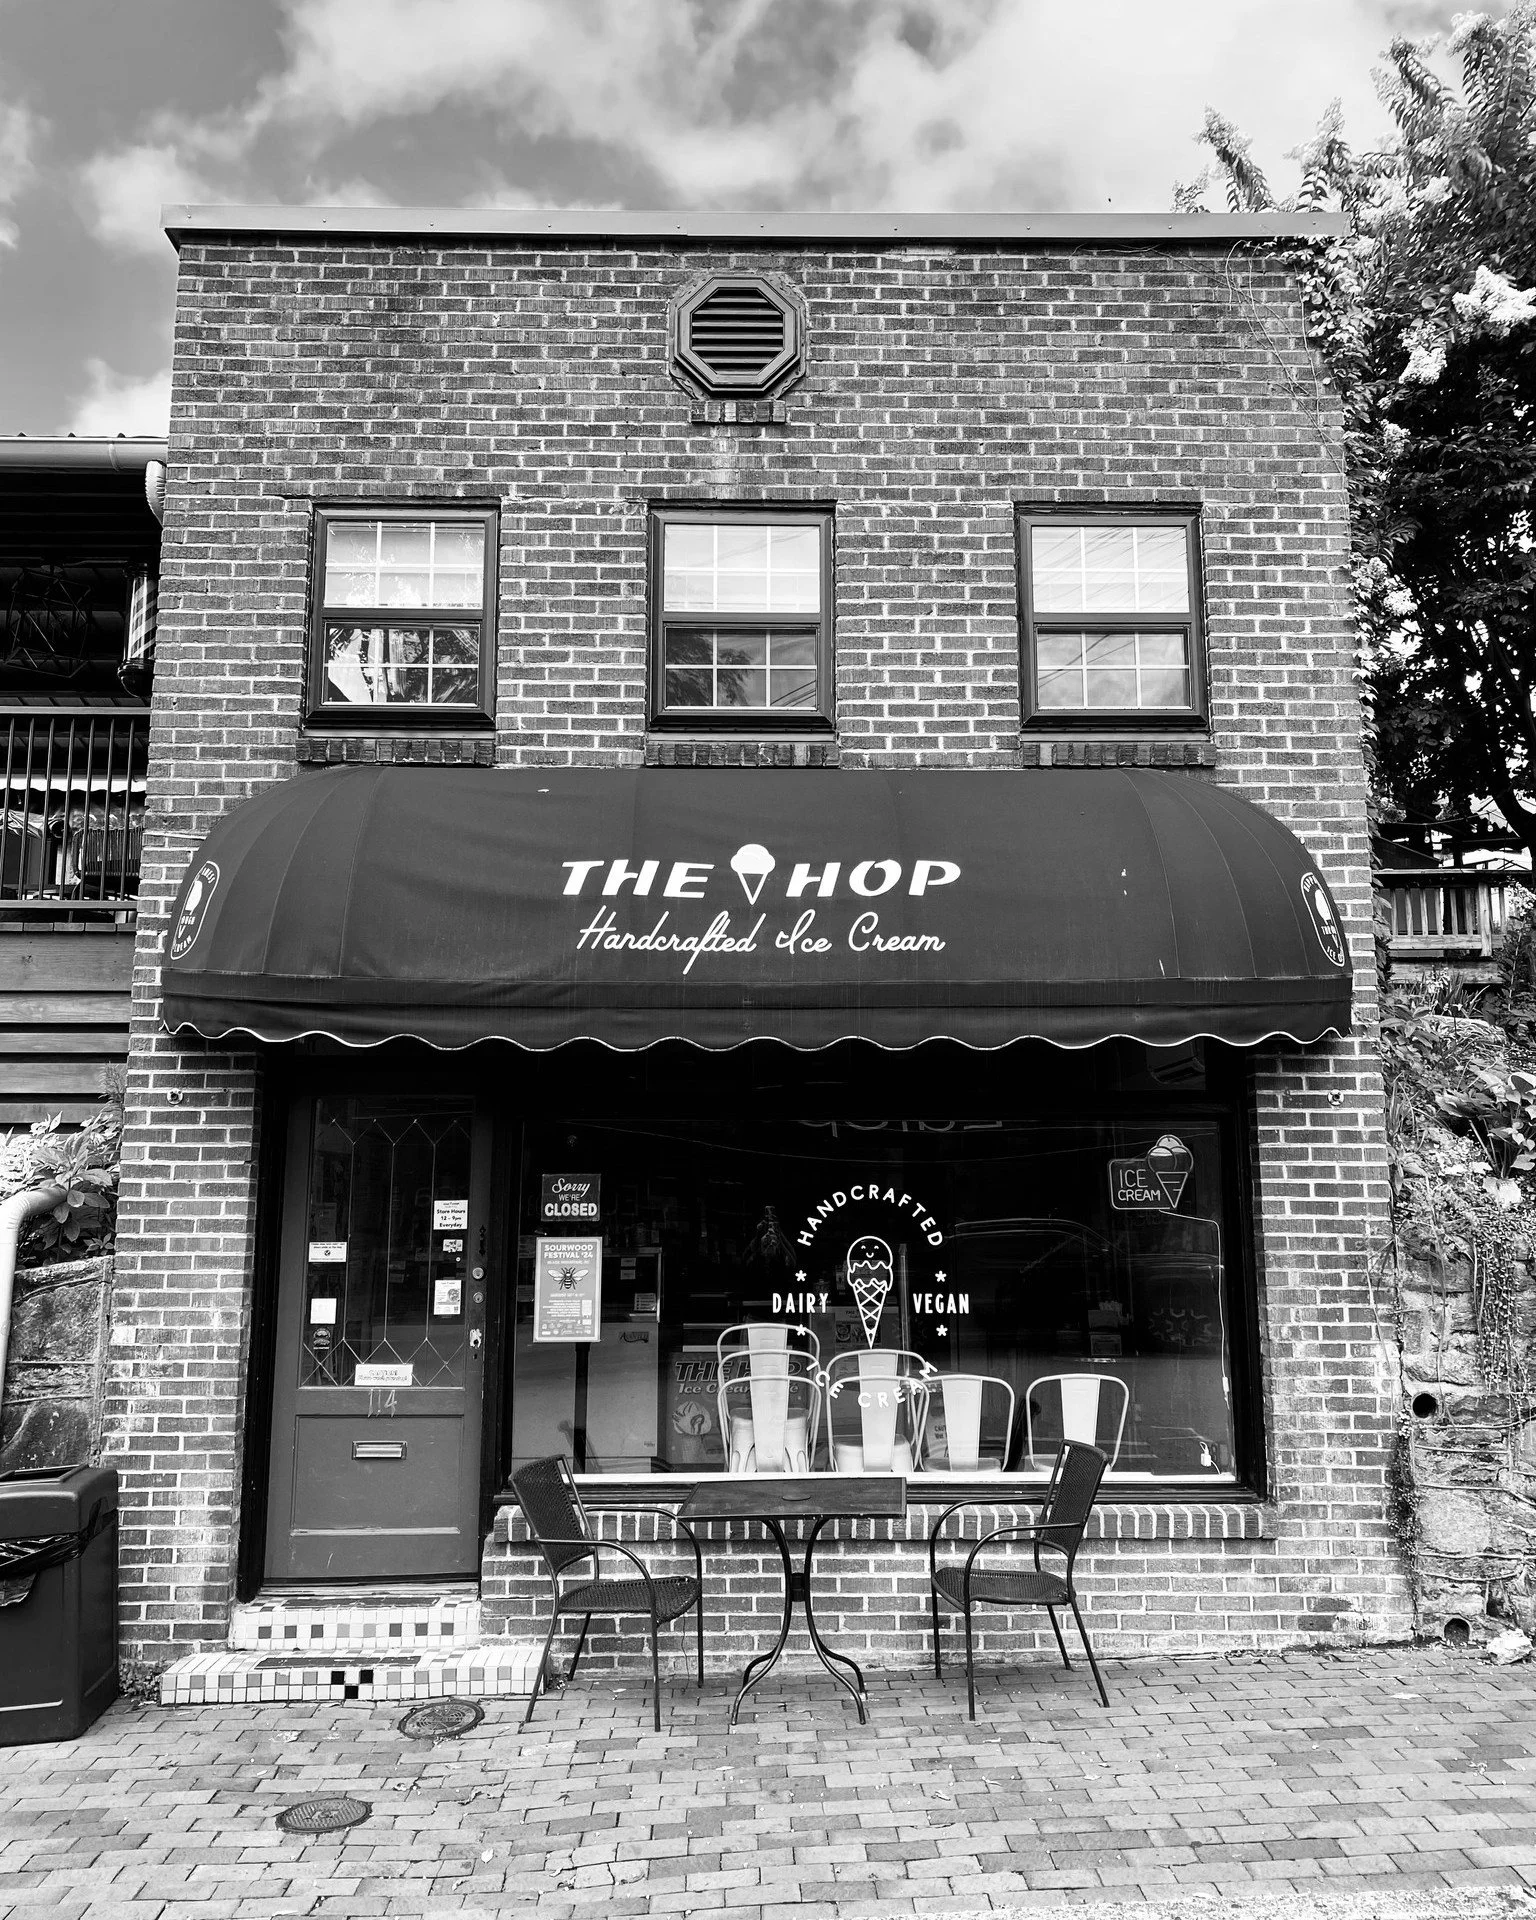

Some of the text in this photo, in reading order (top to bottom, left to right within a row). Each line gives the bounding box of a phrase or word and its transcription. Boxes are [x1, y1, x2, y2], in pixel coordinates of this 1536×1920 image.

[562, 859, 961, 898] THE HOP
[576, 905, 946, 975] Handcrafted Ice Cream
[551, 1177, 591, 1198] Sorry
[1119, 1169, 1149, 1188] ICE
[558, 1193, 580, 1201] WE'RE
[1117, 1189, 1161, 1201] CREAM
[544, 1202, 598, 1218] CLOSED
[797, 1184, 943, 1246] HANDCRAFTED
[543, 1251, 580, 1259] FESTIVAL
[772, 1293, 970, 1314] DAIRY VEGAN
[806, 1361, 938, 1409] ICE CREAM
